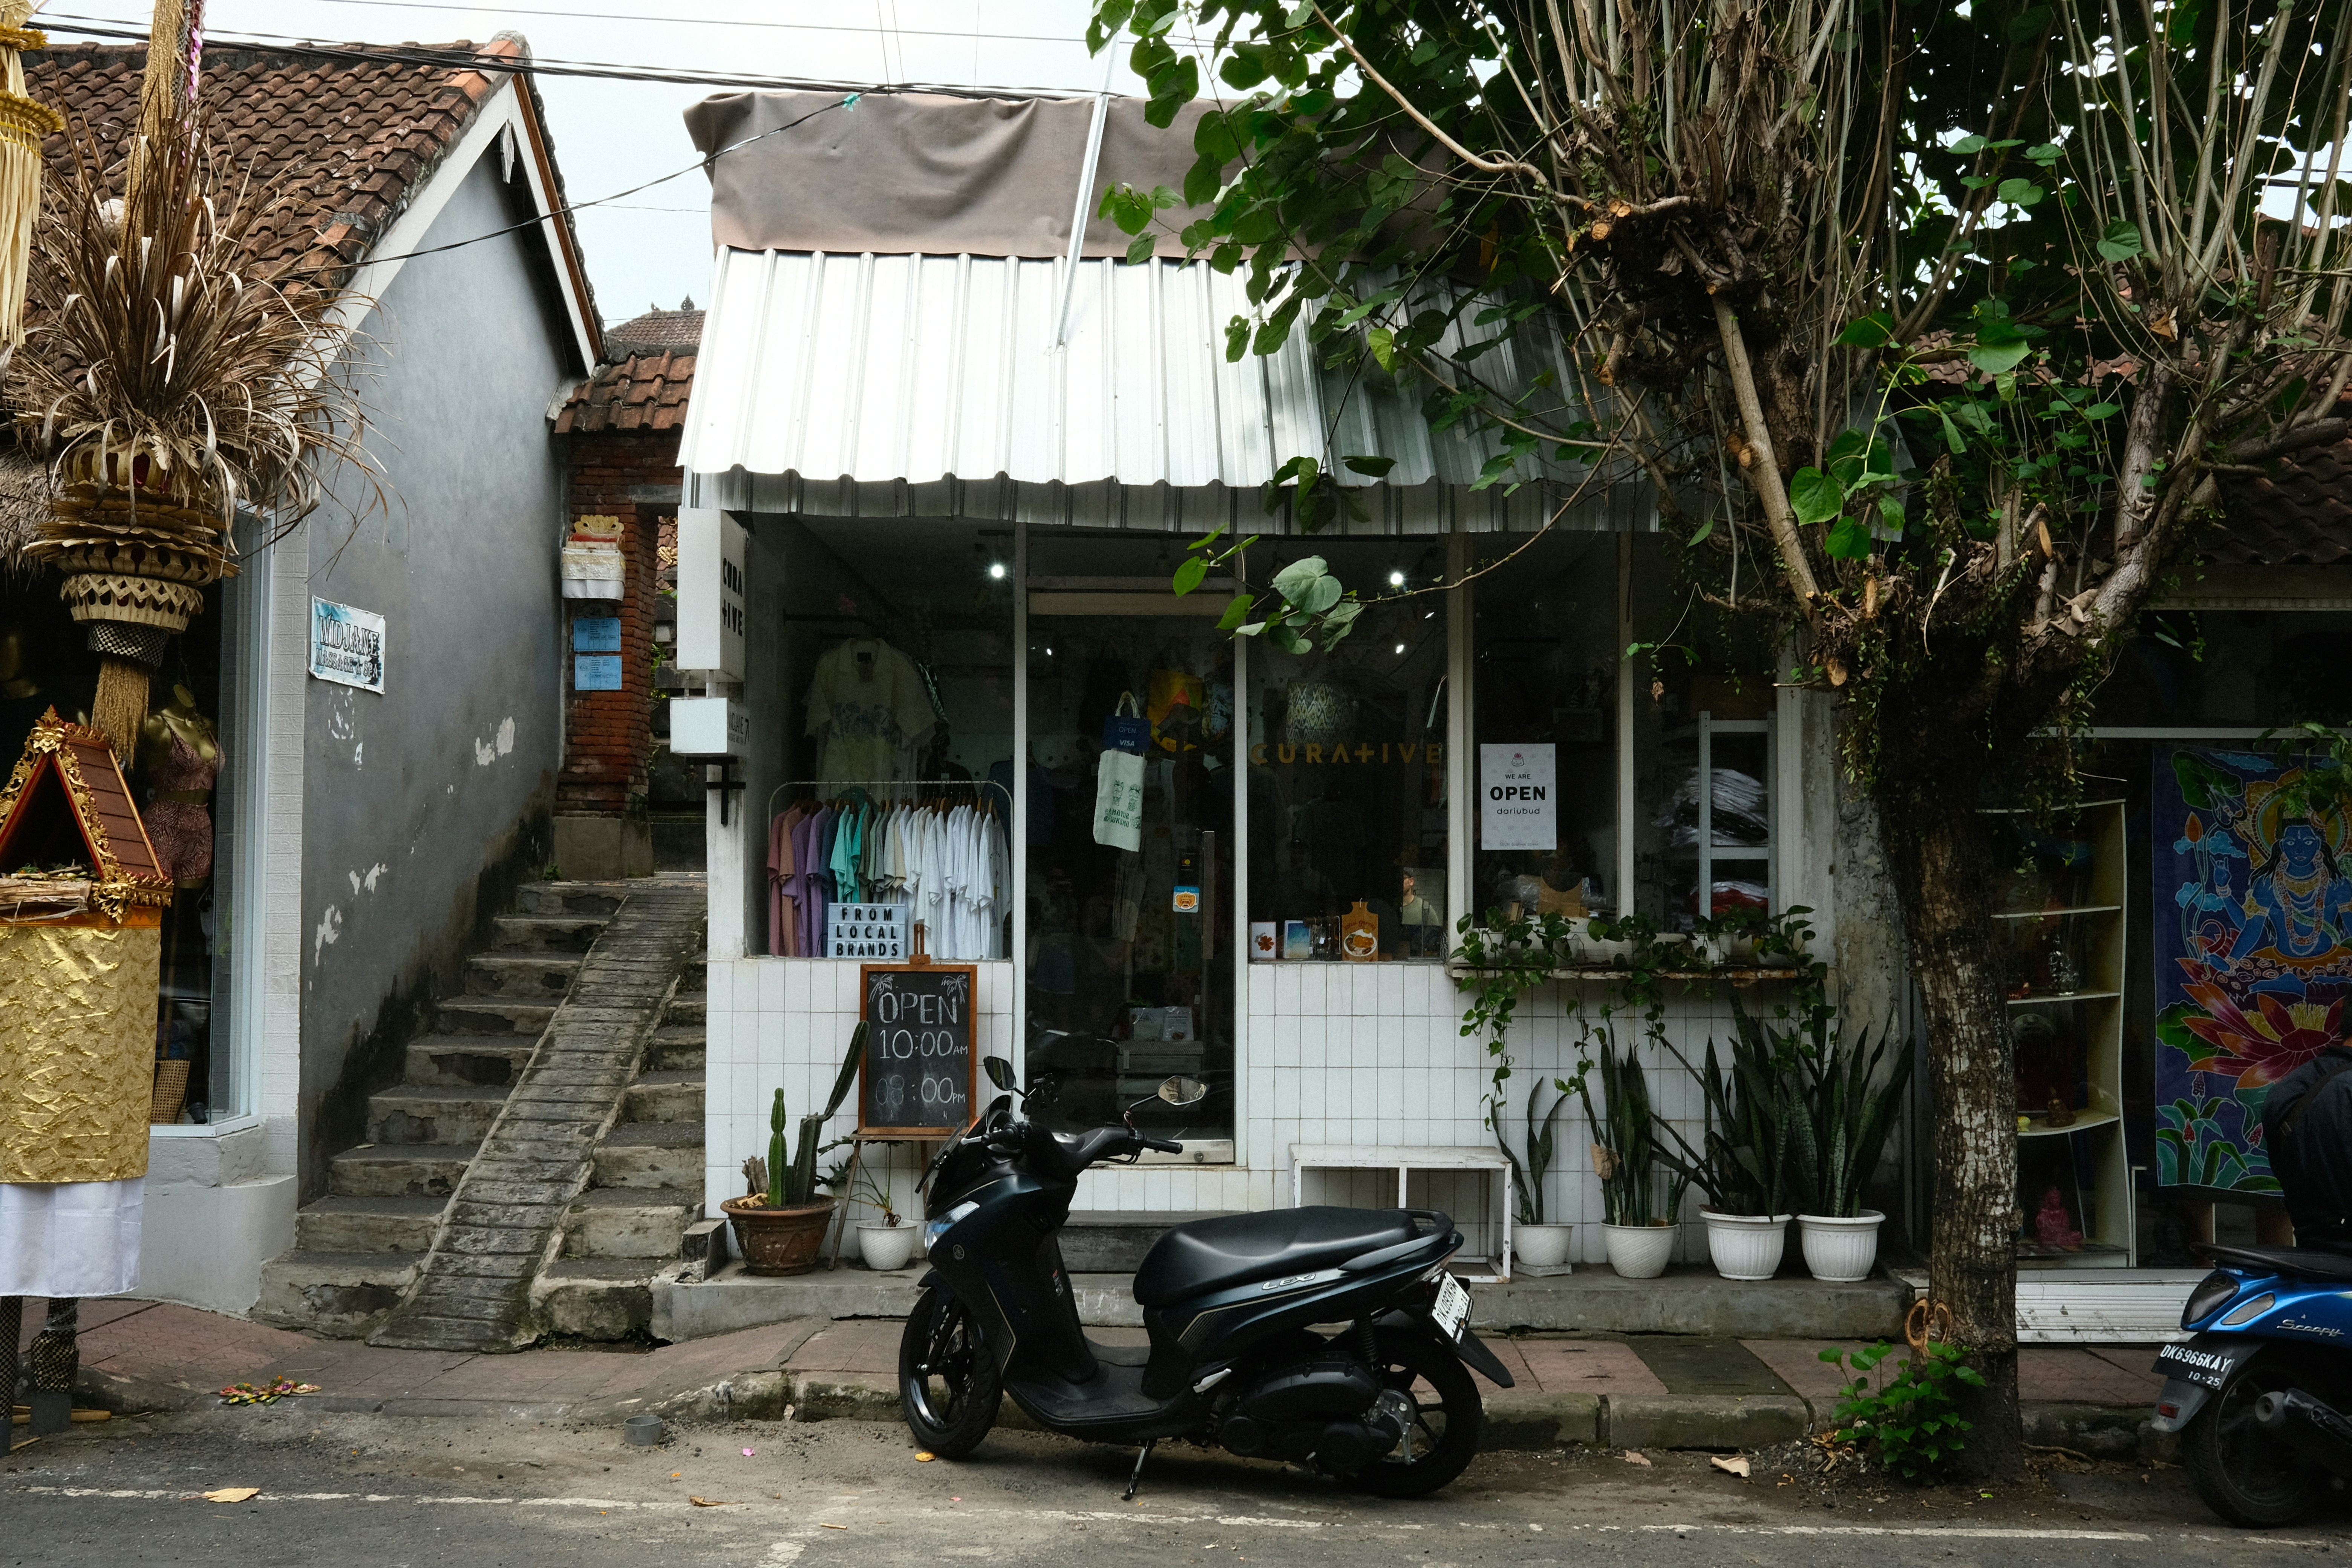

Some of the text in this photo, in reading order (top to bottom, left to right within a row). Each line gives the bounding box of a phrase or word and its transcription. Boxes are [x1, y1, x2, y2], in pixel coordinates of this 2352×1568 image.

[723, 557, 743, 597] CURA
[319, 612, 380, 658] WIDJANE
[315, 648, 354, 674] MASSAGE
[363, 661, 378, 678] SPA
[1490, 786, 1545, 801] OPEN
[842, 907, 892, 921] FROM
[837, 925, 896, 939] LOCAL
[836, 942, 898, 956] BRANDS
[878, 992, 957, 1024] OPEN
[879, 1029, 968, 1059] 10:00 AM
[952, 1093, 966, 1104] PM
[2276, 1319, 2345, 1337] Scoopy
[2160, 1344, 2232, 1372] DK6966KAY
